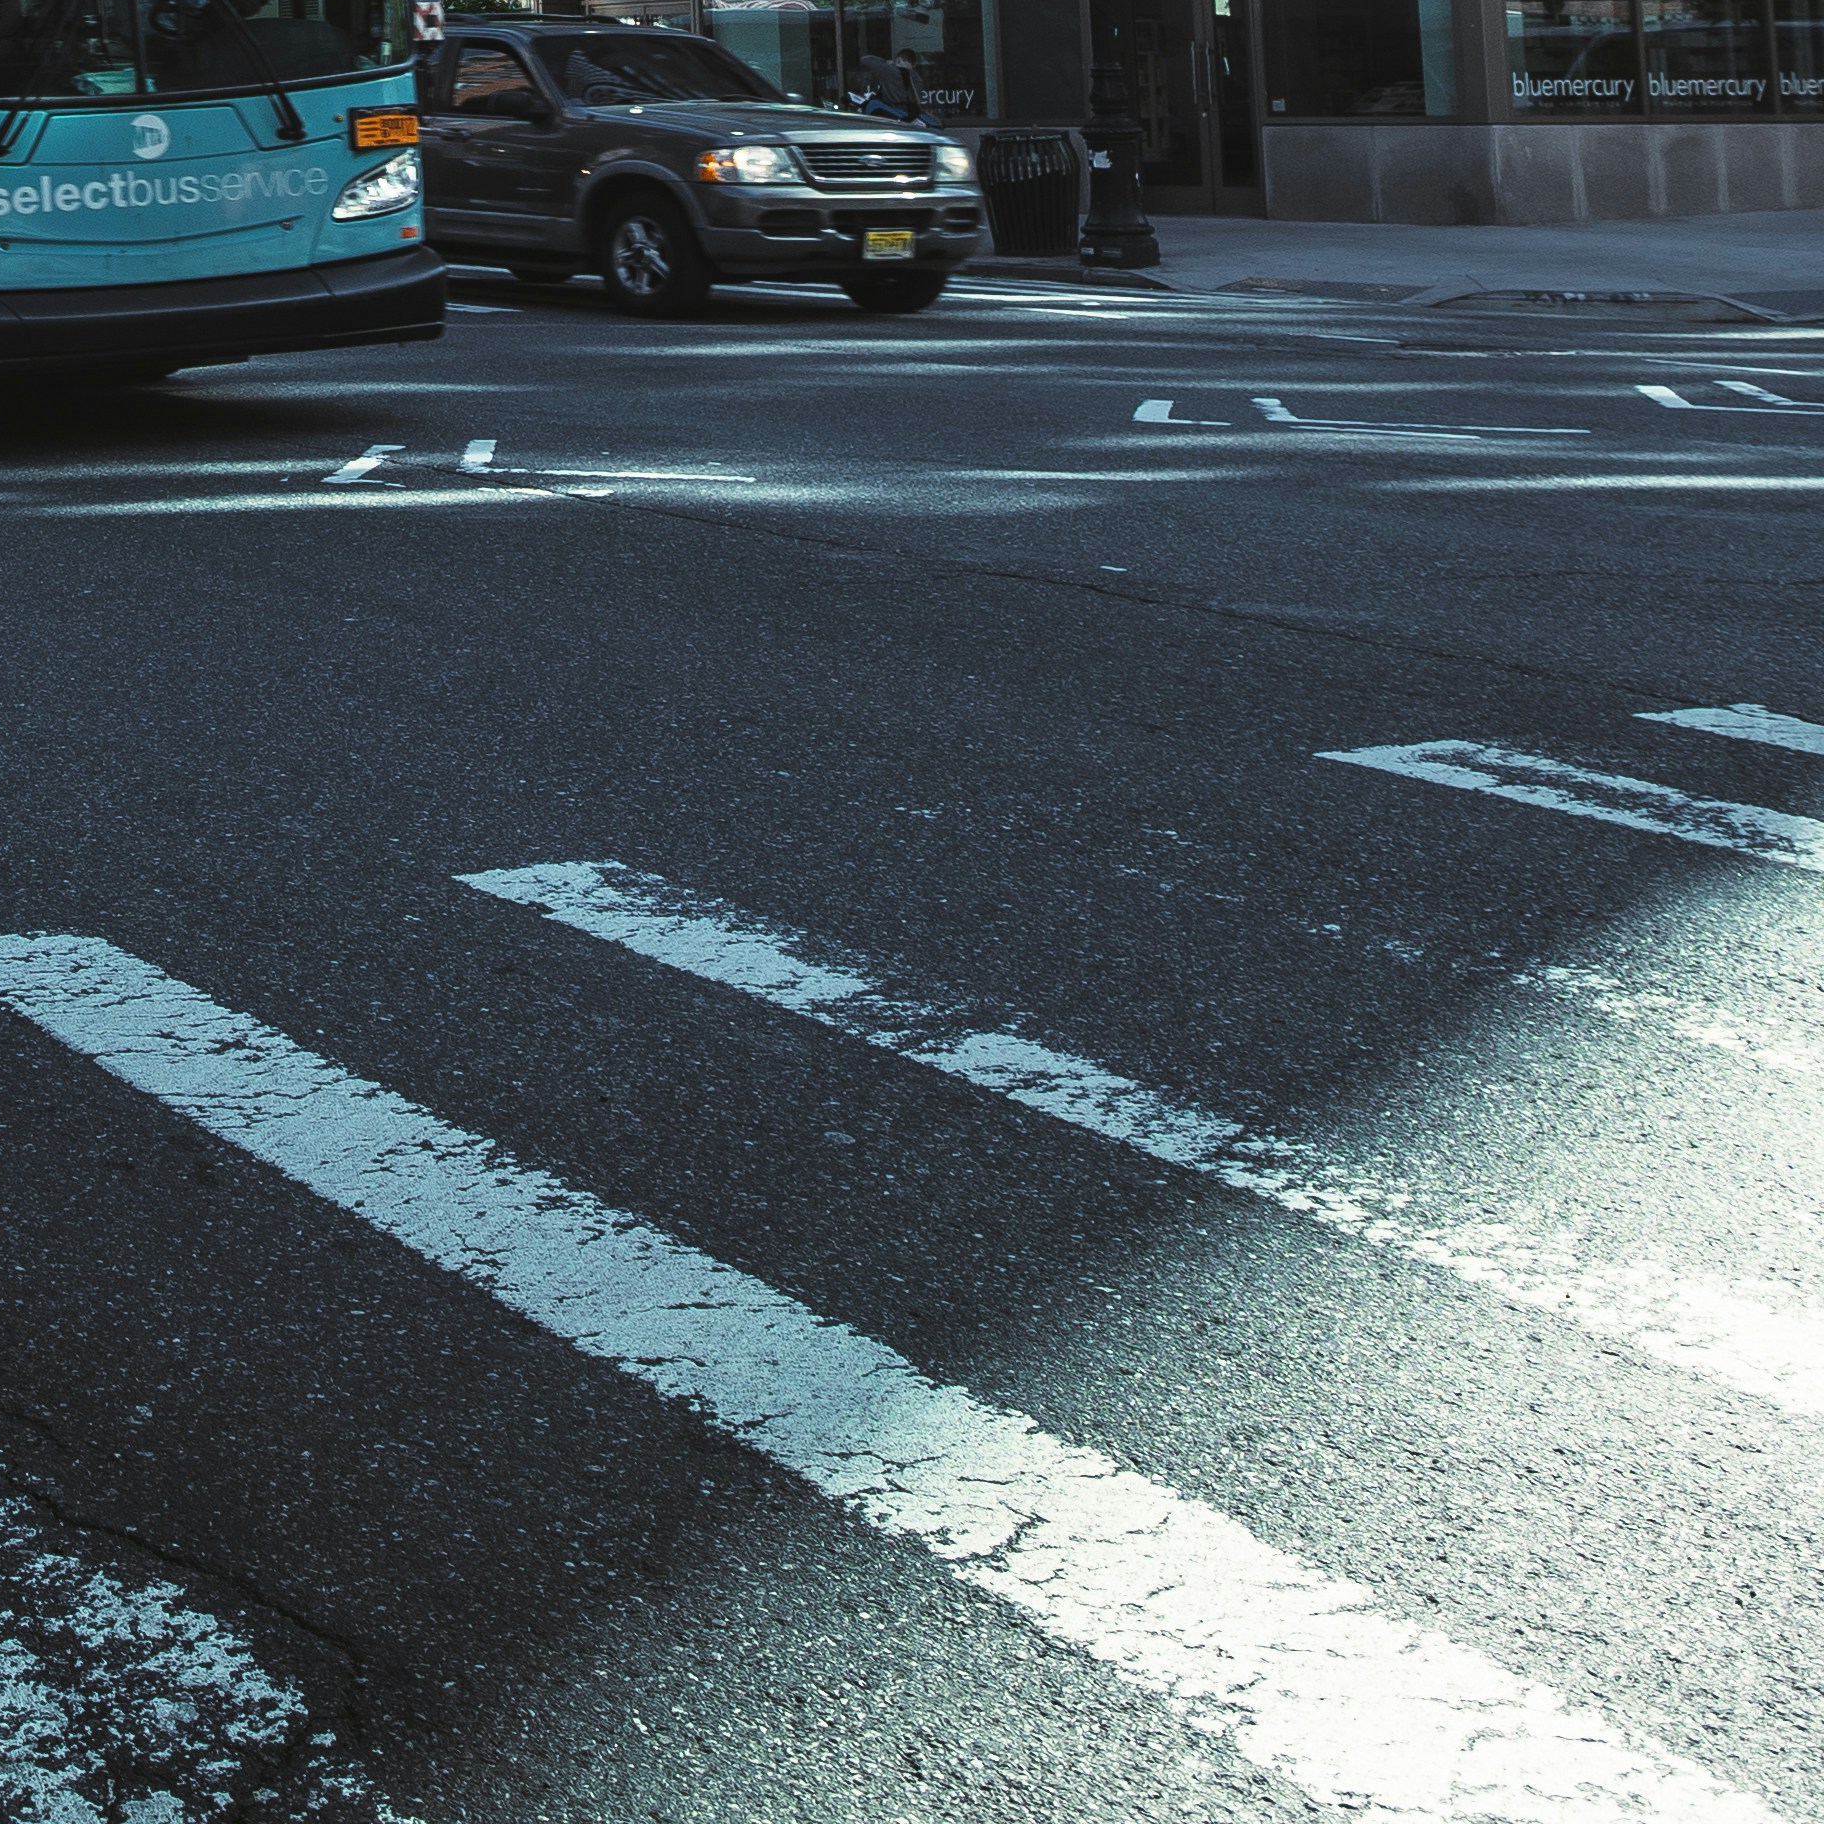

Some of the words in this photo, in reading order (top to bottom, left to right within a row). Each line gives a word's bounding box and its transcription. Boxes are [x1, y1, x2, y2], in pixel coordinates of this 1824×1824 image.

[920, 89, 975, 109] ercury
[1512, 72, 1635, 101] bluemercury
[1648, 72, 1766, 101] bluemercury
